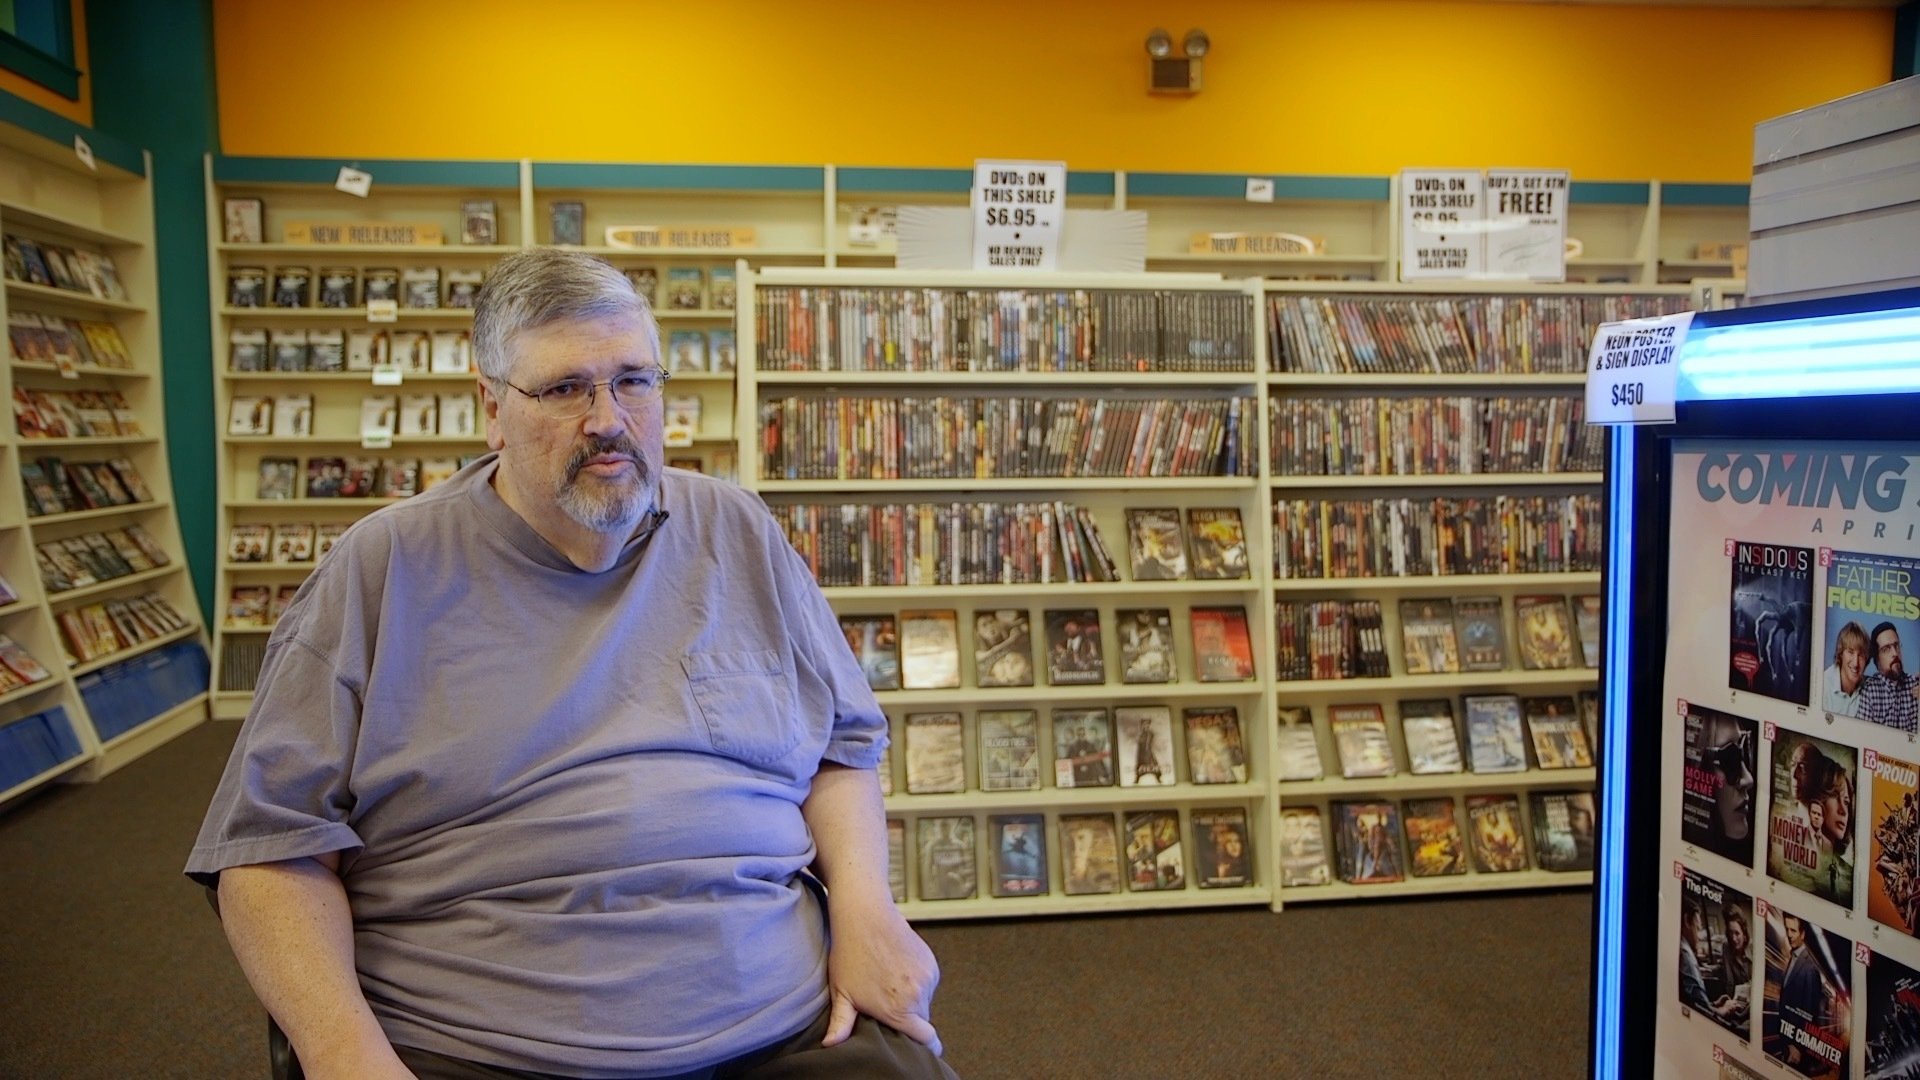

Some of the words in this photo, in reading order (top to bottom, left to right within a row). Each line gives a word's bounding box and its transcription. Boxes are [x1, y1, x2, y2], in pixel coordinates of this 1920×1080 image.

[990, 171, 1024, 185] DVDs
[1028, 172, 1046, 186] ON
[1415, 177, 1445, 191] DVDs
[1449, 178, 1465, 191] ON
[1488, 177, 1509, 189] BUY
[1523, 178, 1542, 190] GET
[1544, 178, 1565, 190] 4TH
[984, 188, 1013, 203] THIS
[1017, 189, 1056, 204] SHELF
[1410, 194, 1437, 208] THIS
[1440, 194, 1475, 209] SHELF
[1499, 192, 1553, 215] FREE!
[986, 208, 1036, 226] $6.95
[310, 226, 342, 243] NEW
[349, 226, 416, 244] RELEASES
[668, 231, 731, 247] RELEASES
[988, 246, 1001, 256] NO
[1003, 246, 1043, 256] RENTALS
[1211, 237, 1238, 253] NEW
[1245, 237, 1301, 253] RELEASES
[1417, 248, 1429, 258] NO
[1431, 248, 1468, 258] RENTALS
[989, 256, 1016, 266] SALES
[1019, 256, 1041, 266] ONLY
[1419, 258, 1444, 269] SALES
[1446, 258, 1467, 269] ONLY
[1596, 356, 1603, 370] &
[1605, 349, 1630, 370] SIGN
[1630, 345, 1675, 367] DISPLAY
[1611, 382, 1644, 407] $450
[1696, 452, 1911, 513] COMING
[1821, 554, 1829, 566] 3
[1760, 568, 1784, 577] LAST
[1789, 571, 1808, 580] KEY
[1836, 564, 1912, 595] FATHER
[1827, 585, 1920, 621] FIGURES
[1865, 755, 1877, 769] 10
[1685, 766, 1725, 789] MOLLY'S
[1873, 761, 1917, 788] PROUD
[1685, 778, 1713, 797] GAME
[1773, 816, 1808, 846] MONEY
[1783, 842, 1818, 870] WORLD
[1684, 877, 1702, 895] The
[1701, 884, 1723, 904] Post
[1779, 1018, 1796, 1039] THE
[1795, 1027, 1842, 1066] COMMUTER
